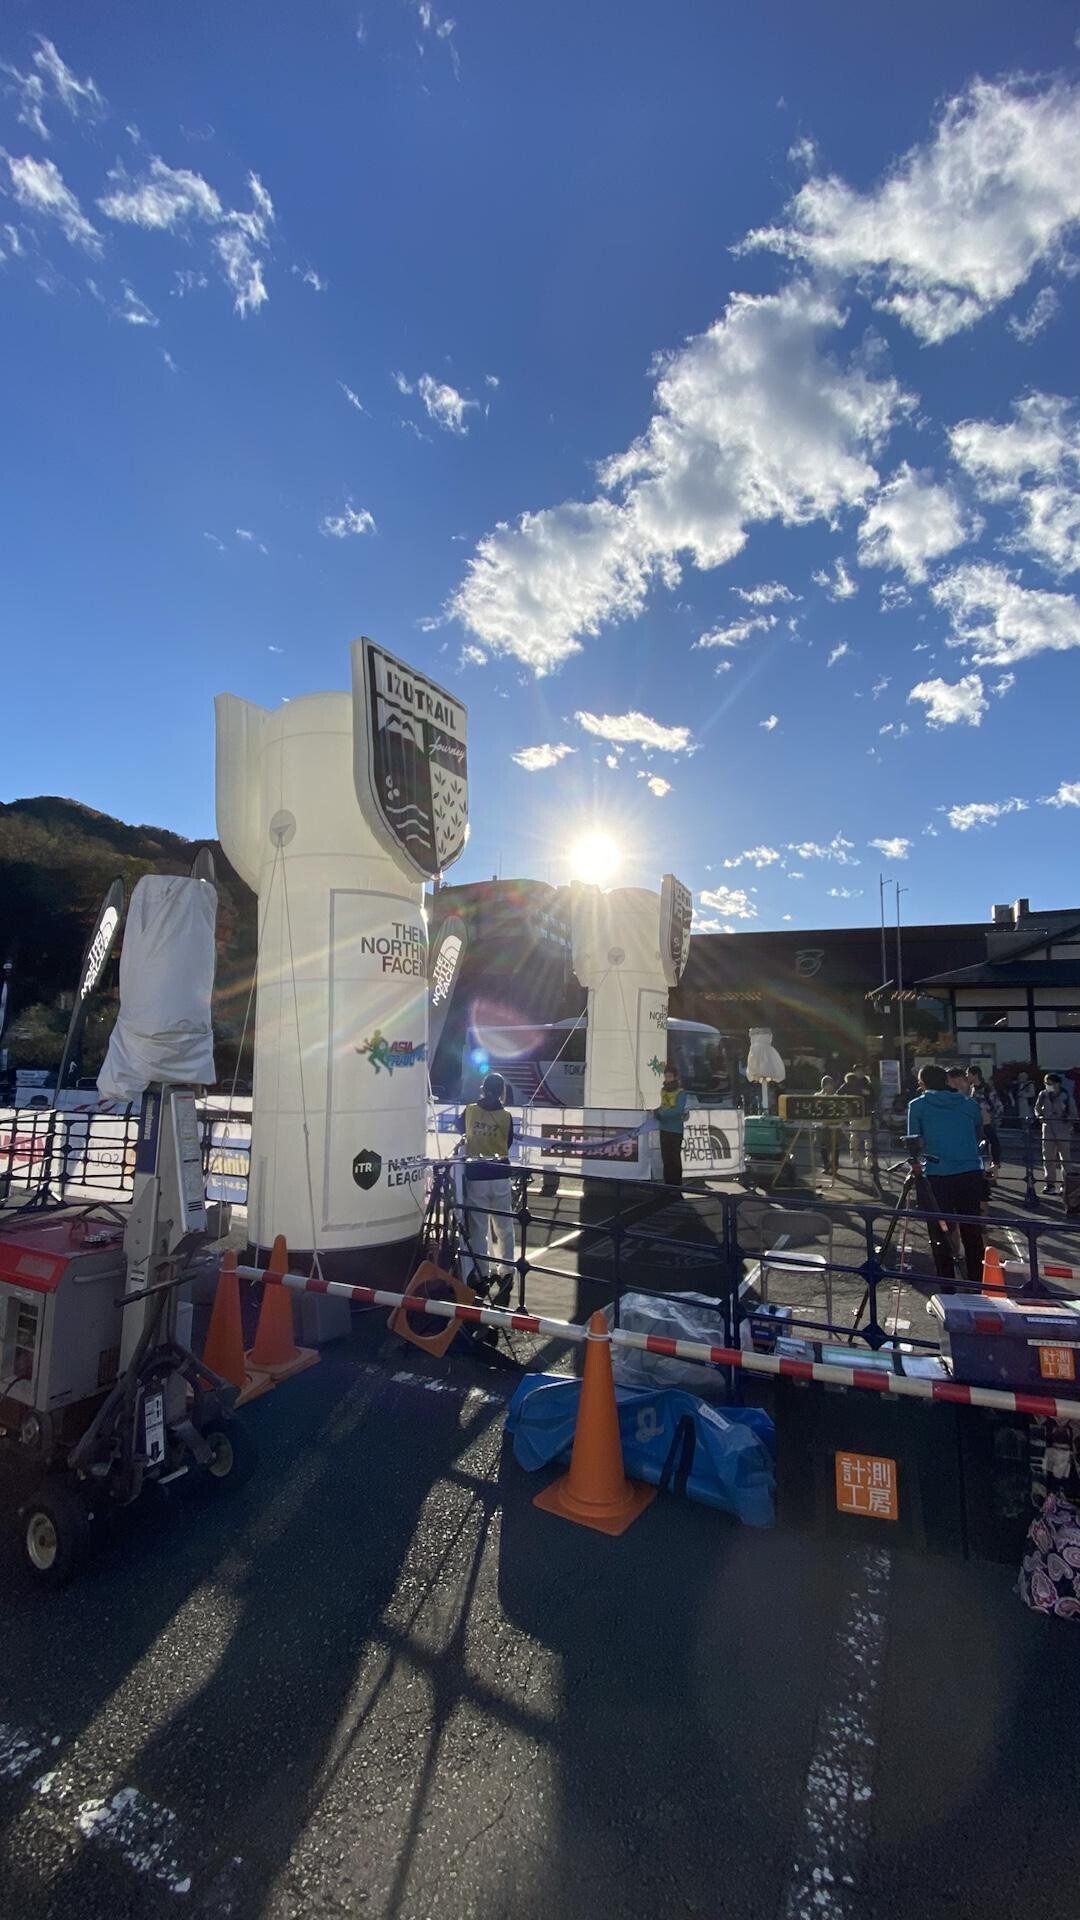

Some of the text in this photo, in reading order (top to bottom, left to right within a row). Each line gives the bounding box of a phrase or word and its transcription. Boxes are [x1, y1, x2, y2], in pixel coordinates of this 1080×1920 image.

[428, 736, 465, 762] Journey
[391, 922, 419, 943] THE
[361, 936, 419, 959] NORTH
[382, 956, 419, 976] FACE
[433, 953, 444, 978] THE
[432, 958, 449, 1006] NORTH
[441, 965, 455, 999] FACE
[390, 1041, 413, 1052] ASIA
[686, 1124, 708, 1136] THE
[681, 1136, 710, 1150] ORTH
[683, 1149, 713, 1162] FACE
[841, 1457, 891, 1488] 計測
[841, 1483, 892, 1513] 工房
